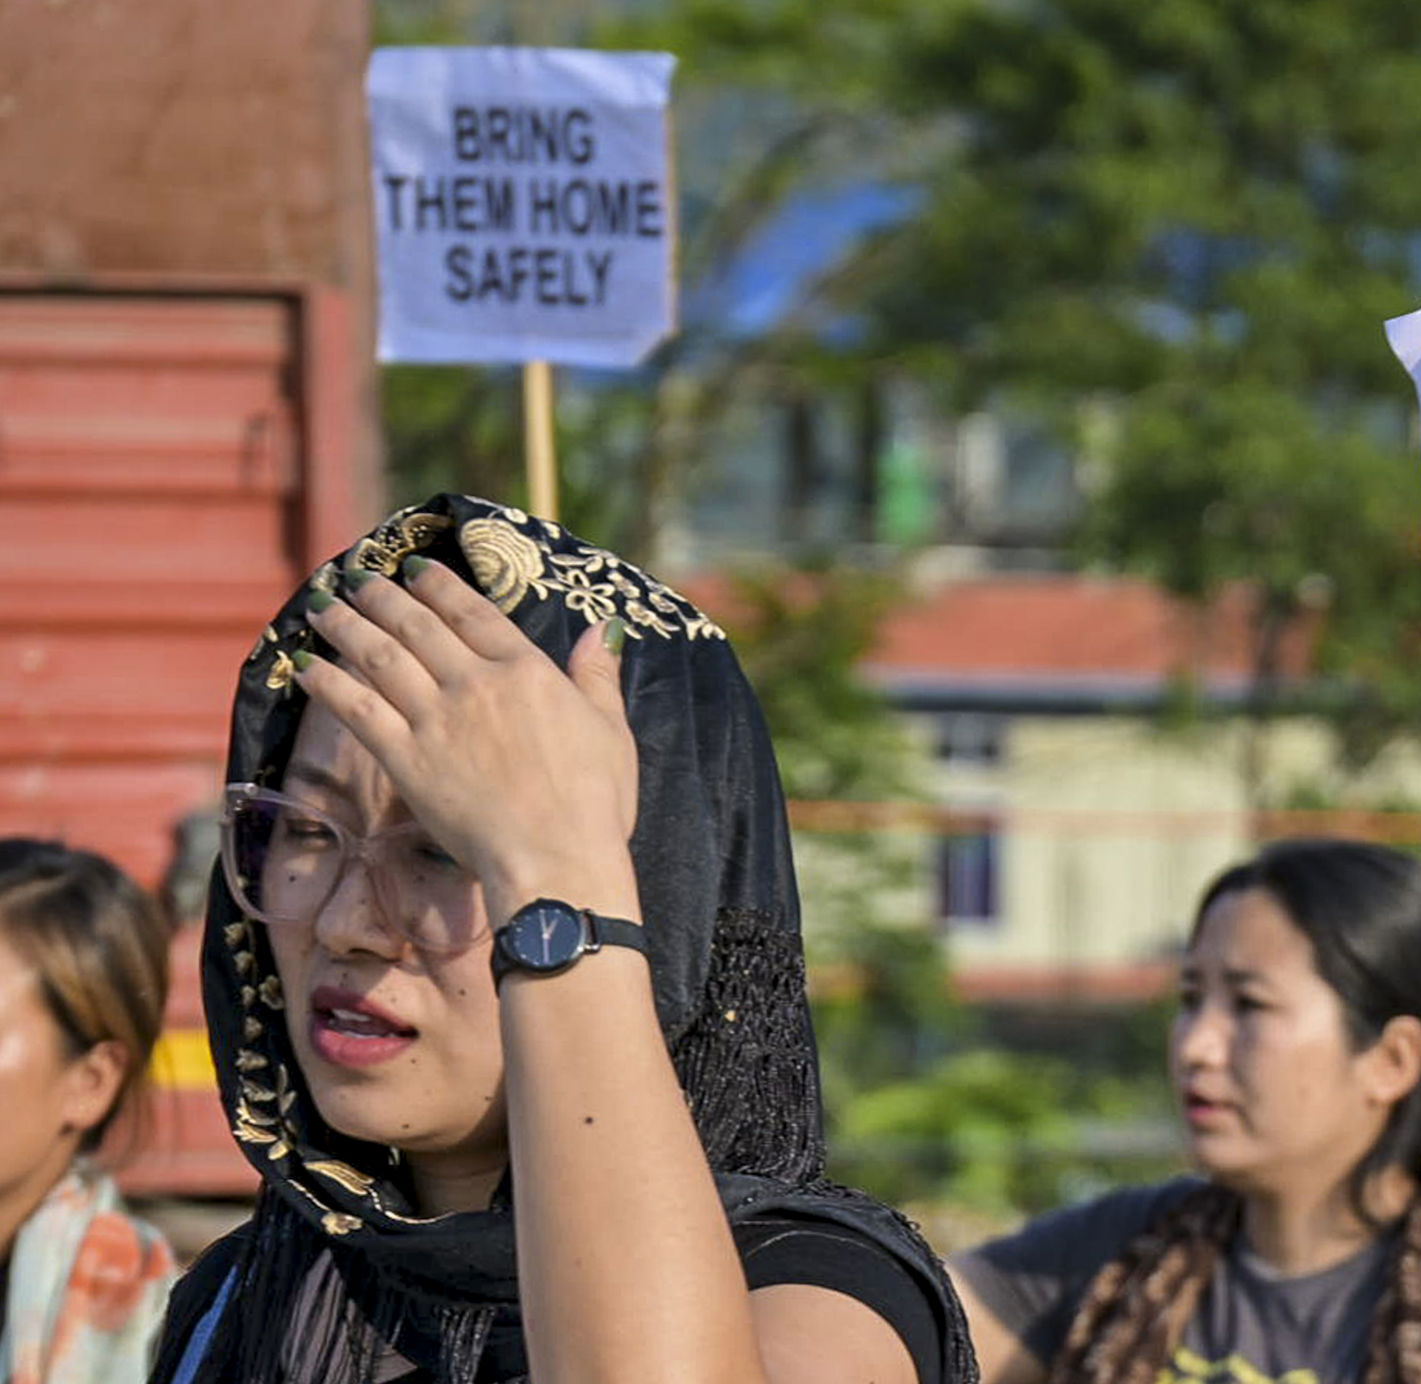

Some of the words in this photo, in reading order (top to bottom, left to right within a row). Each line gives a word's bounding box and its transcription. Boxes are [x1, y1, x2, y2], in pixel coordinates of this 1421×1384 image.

[453, 107, 597, 166] BRING
[384, 174, 515, 234] THEM
[528, 179, 663, 238] HOME
[446, 245, 613, 306] SAFELY
